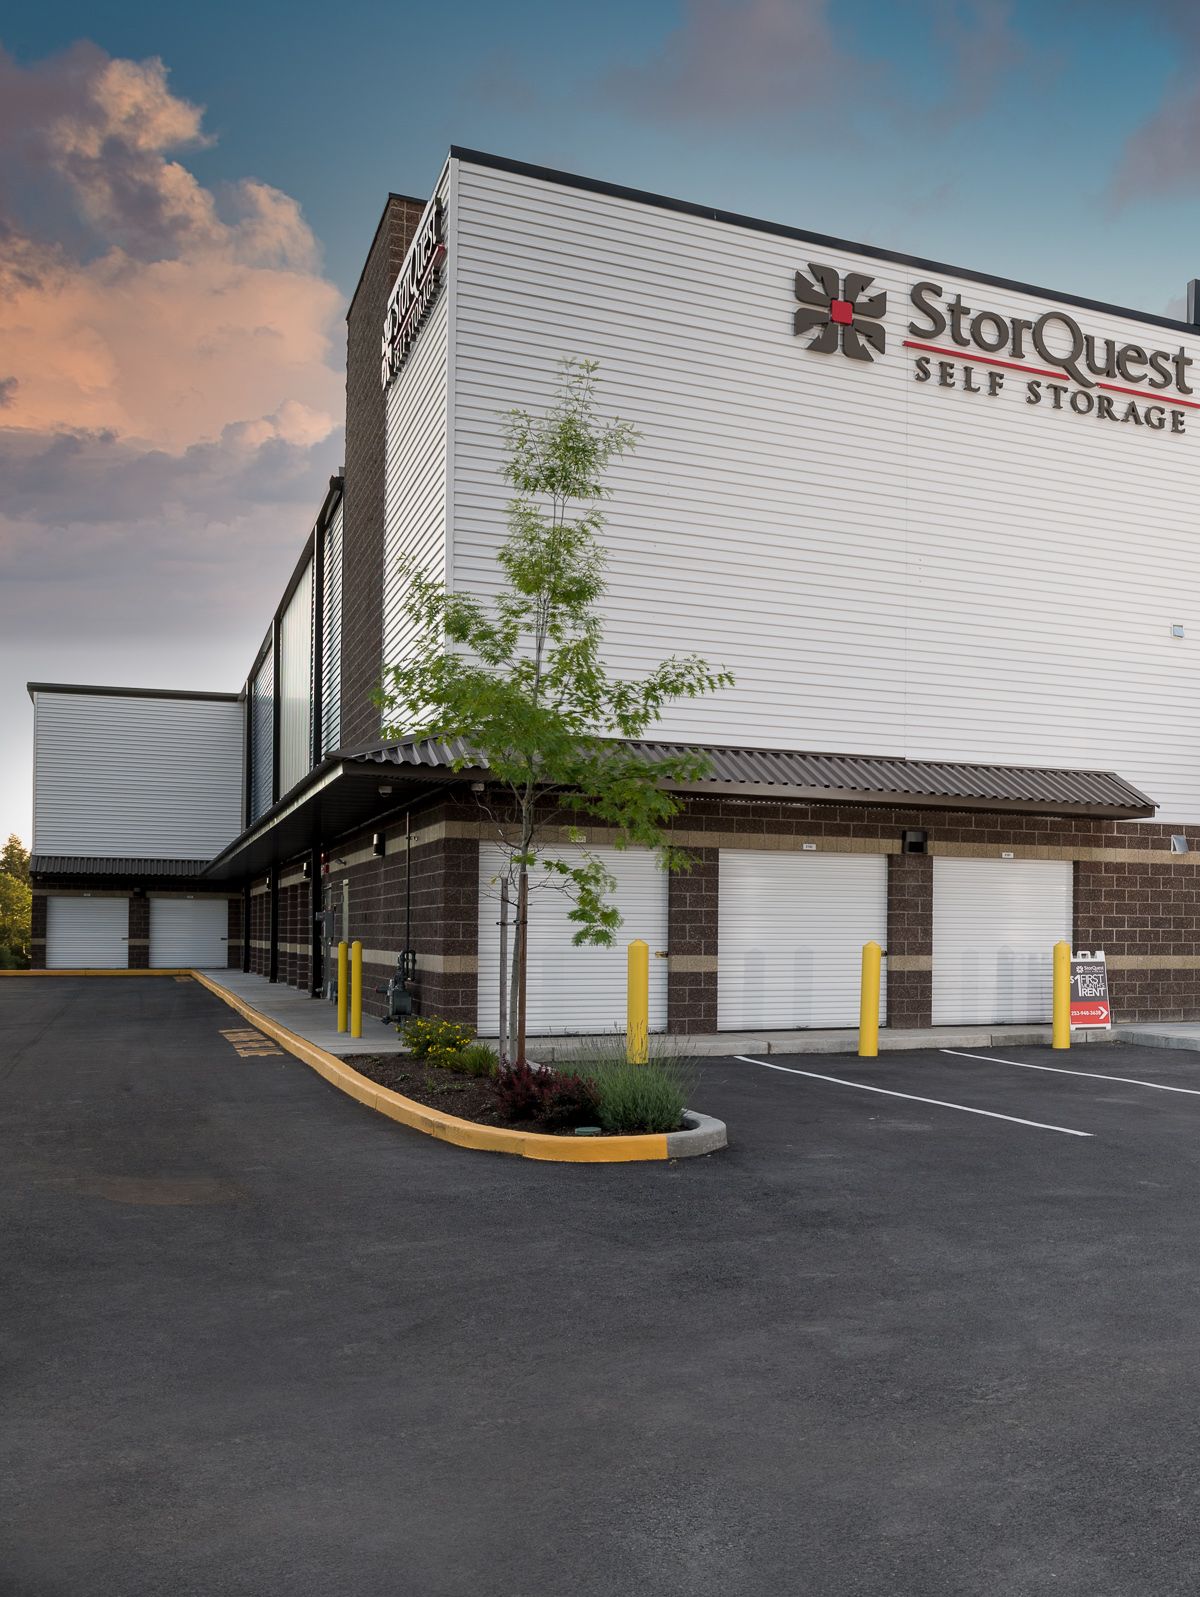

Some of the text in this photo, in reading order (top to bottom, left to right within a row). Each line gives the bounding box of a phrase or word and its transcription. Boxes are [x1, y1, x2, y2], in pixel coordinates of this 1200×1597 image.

[909, 281, 1194, 395] StorQuest
[915, 356, 1187, 434] SELF STORAGE
[1081, 974, 1104, 984] FIRST
[1082, 988, 1106, 997] RENT
